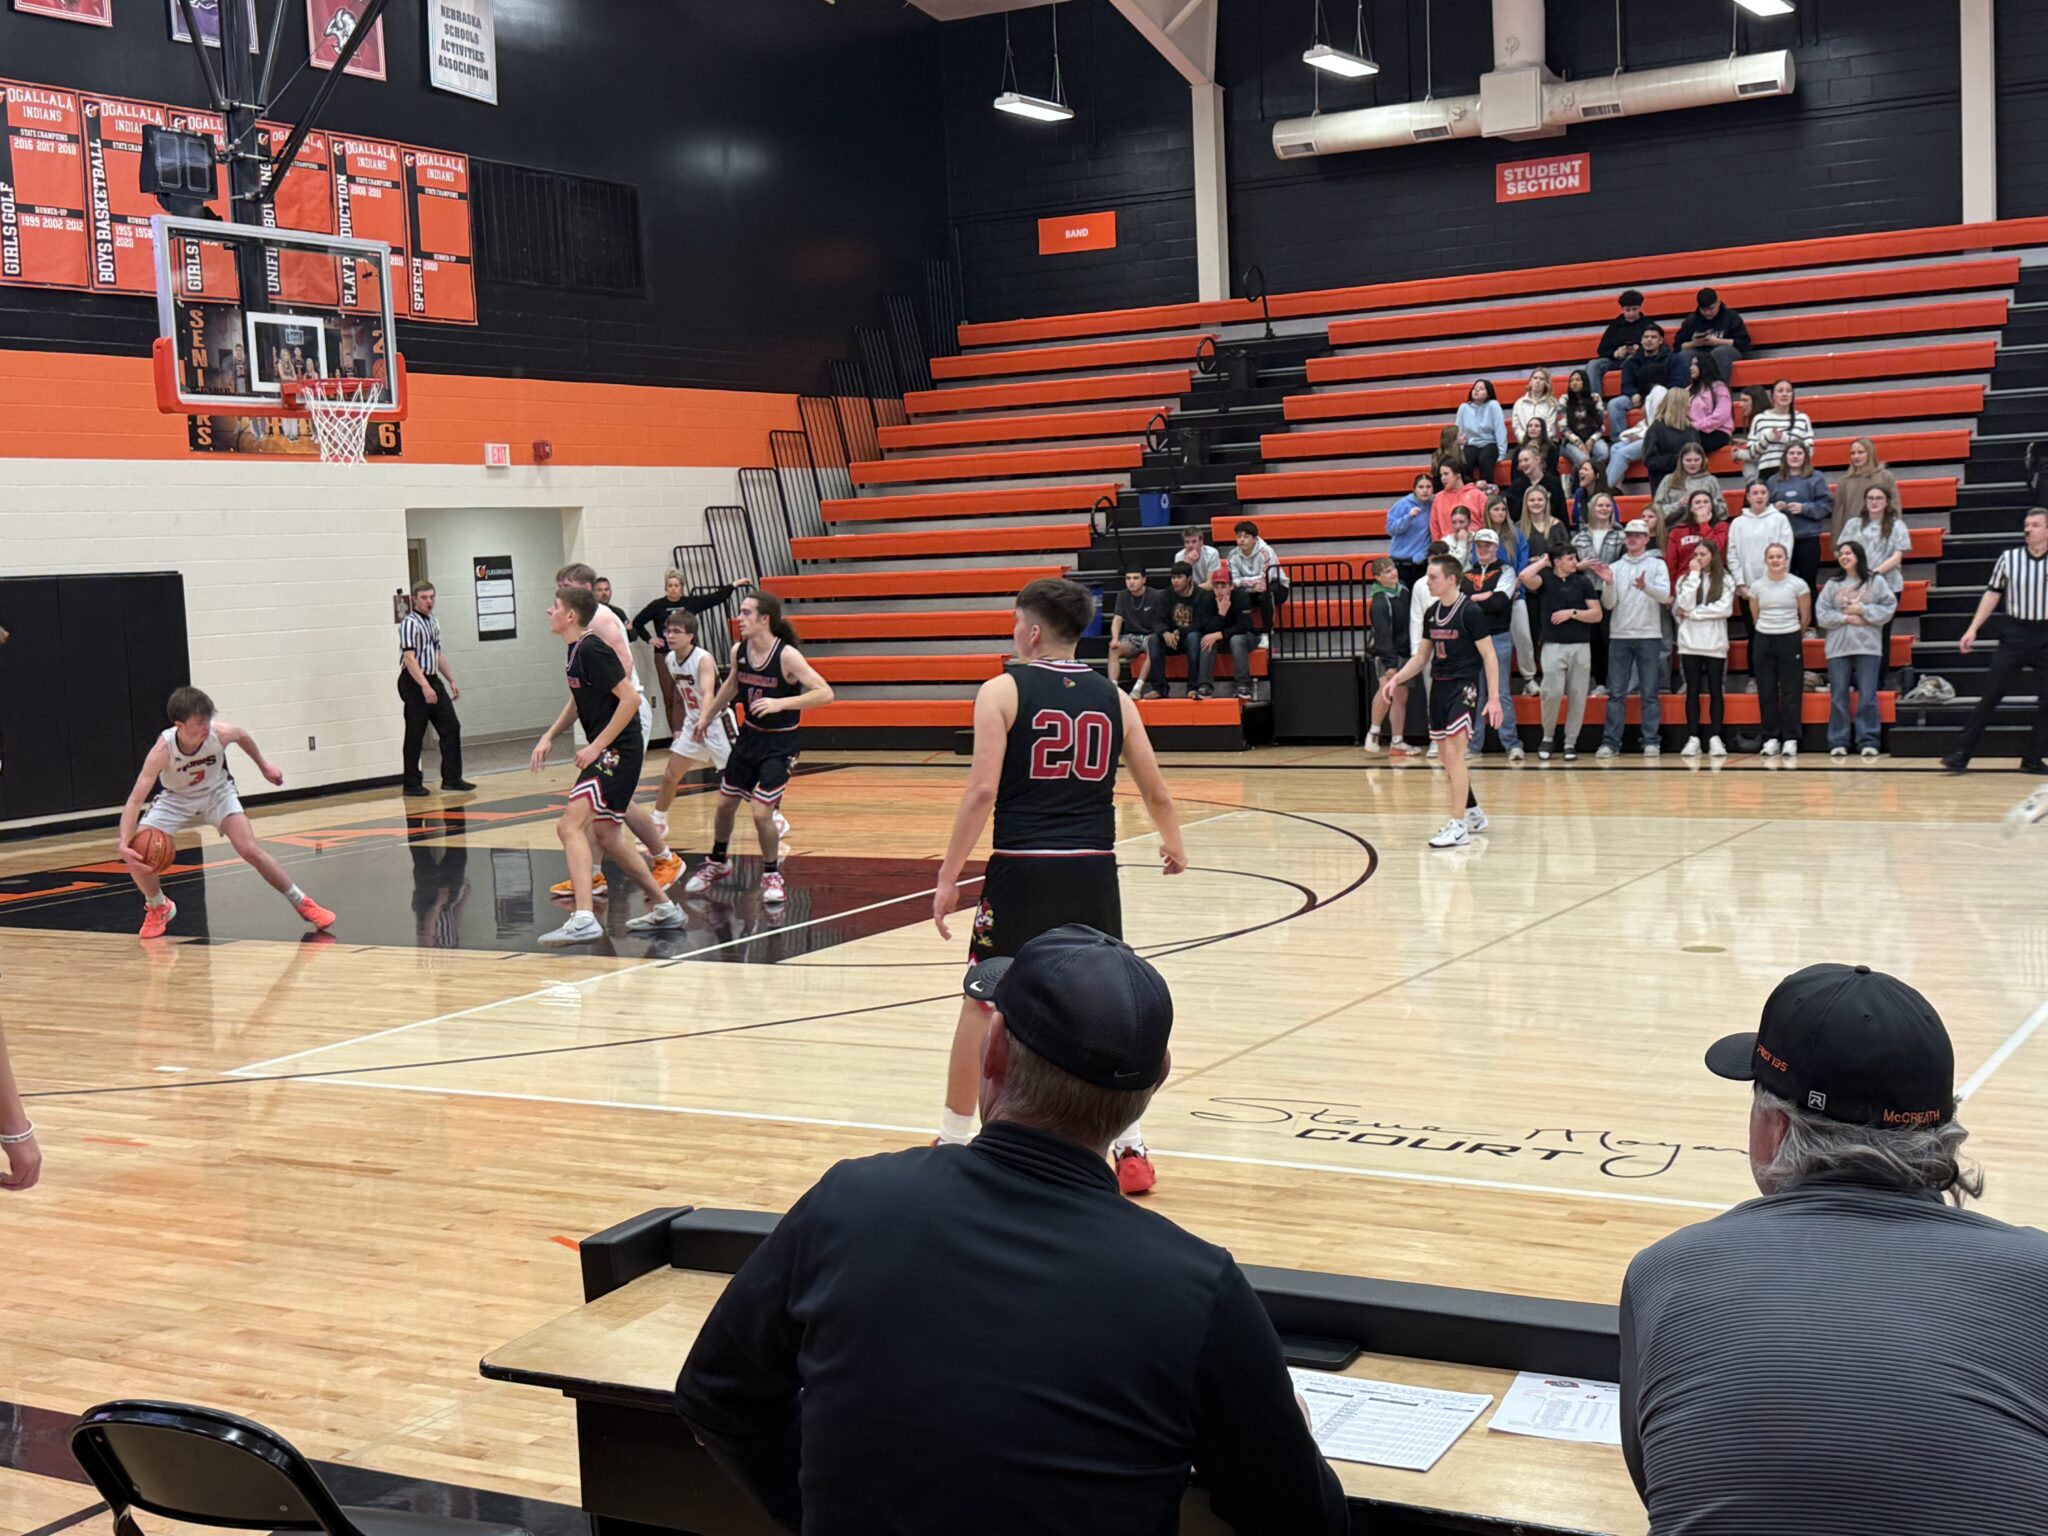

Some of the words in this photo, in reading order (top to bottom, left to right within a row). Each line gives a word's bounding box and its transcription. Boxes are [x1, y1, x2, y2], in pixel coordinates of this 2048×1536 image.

[440, 5, 482, 30] NEBRASKA
[444, 23, 480, 45] SCHOOLS
[440, 38, 485, 63] ACTIVITIES
[438, 54, 489, 81] ASSOCIATION
[7, 87, 74, 112] OGALLALA
[22, 106, 62, 122] INDIANS
[101, 102, 163, 126] OGALLALA
[187, 116, 224, 131] OGALL
[115, 119, 142, 133] INDIA
[36, 140, 55, 152] 2017
[272, 131, 324, 151] OGAALA
[345, 141, 397, 162] OGALLALA
[356, 156, 387, 171] INDIANS
[416, 153, 464, 174] OGALLALA
[1503, 160, 1582, 182] STUDENT
[427, 167, 455, 183] INDIANS
[1506, 174, 1580, 195] SECTION
[90, 138, 111, 241] BASKETBALL
[0, 181, 17, 224] GOLF
[21, 215, 40, 227] 1999
[42, 217, 64, 230] 2002
[65, 219, 84, 232] 2012
[127, 216, 152, 226] RUNNER-
[336, 174, 355, 266] PDUCTION
[115, 226, 133, 237] 1955
[1065, 227, 1089, 239] BAND
[2, 225, 20, 275] GIRLS
[97, 242, 115, 283] BOYS
[186, 244, 202, 291] GIRLS
[265, 246, 280, 292] UNIFI
[342, 265, 357, 305] PLAY
[412, 257, 424, 311] SPEECH
[1029, 708, 1113, 782] 20
[189, 769, 205, 787] 3
[1295, 1128, 1583, 1161] COURT
